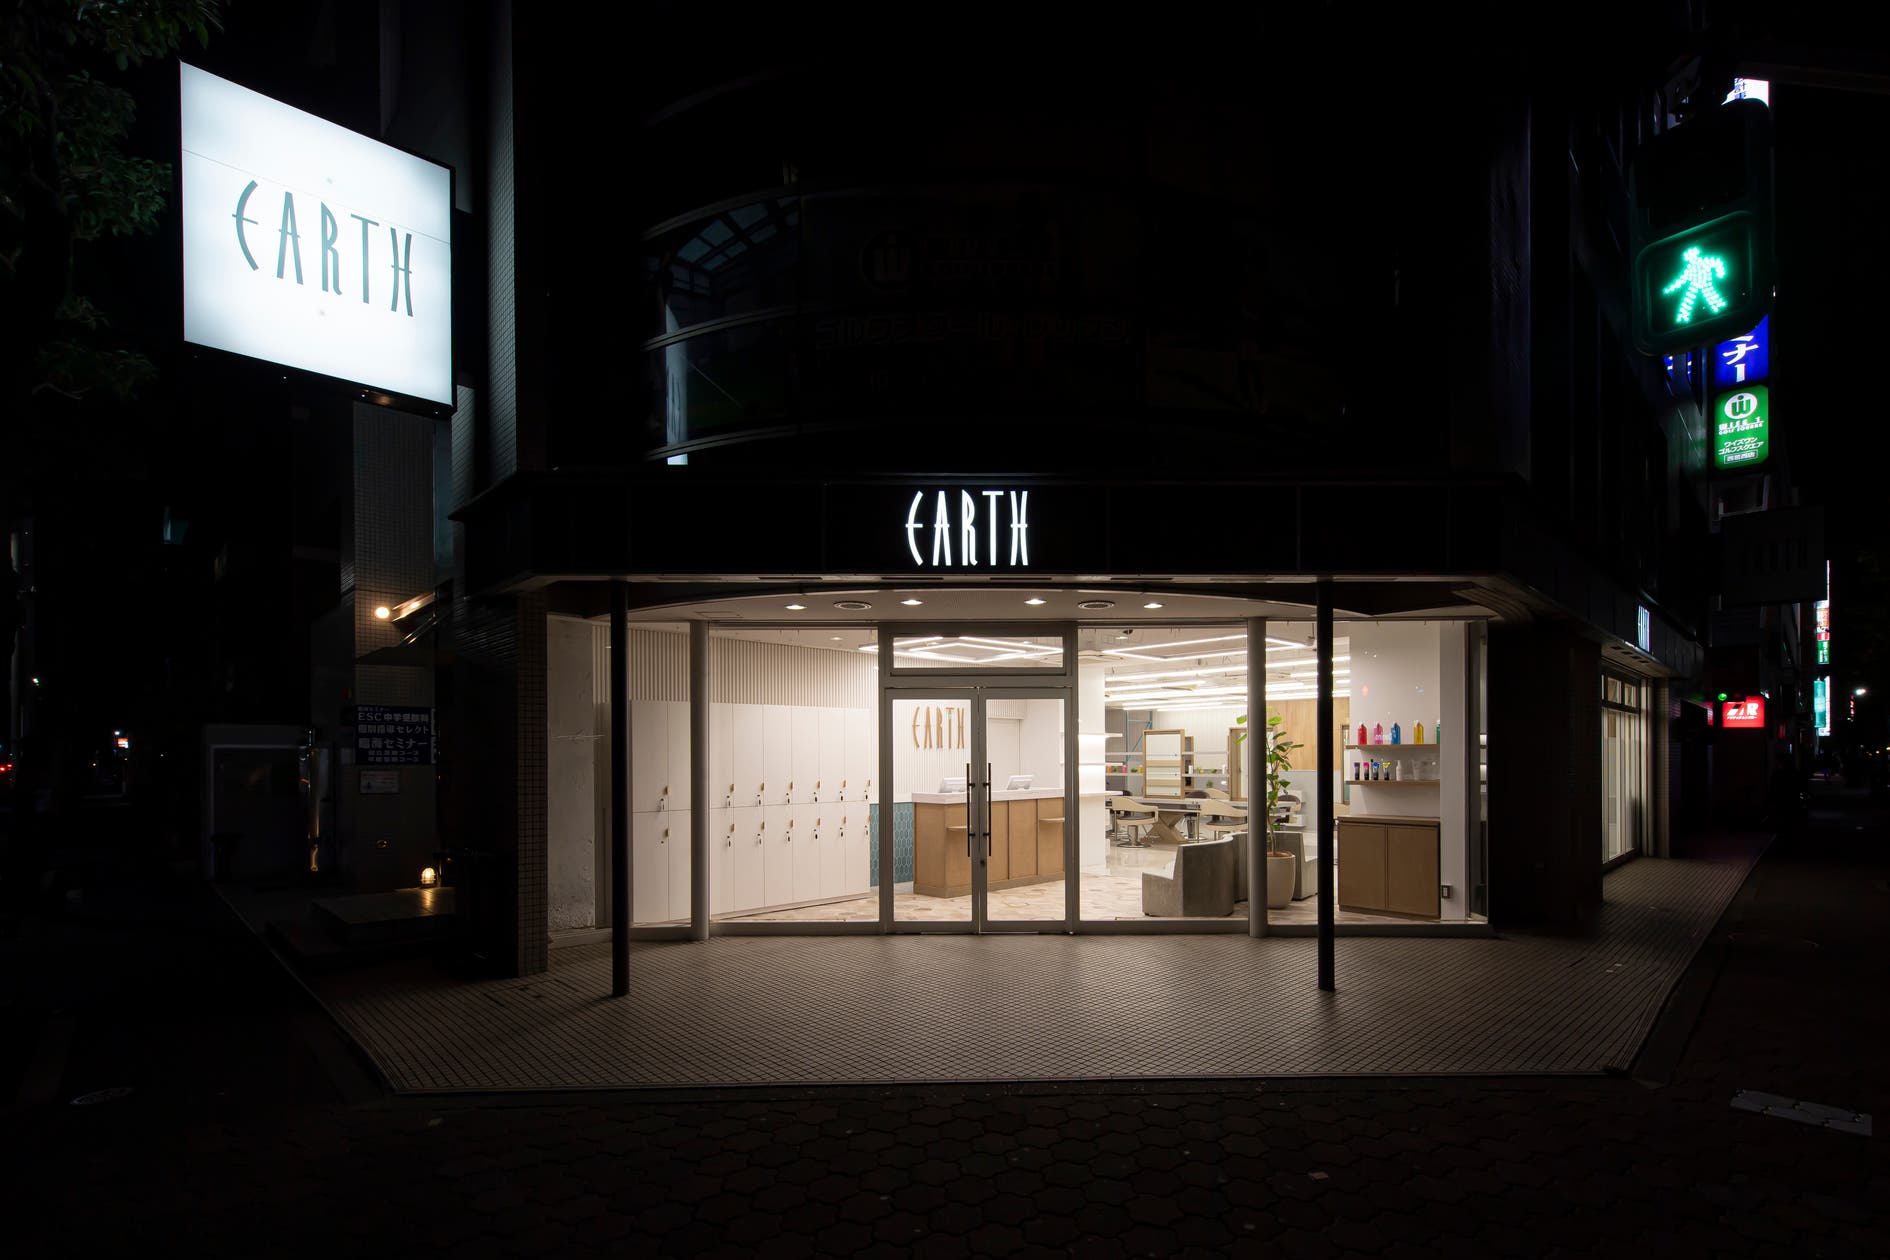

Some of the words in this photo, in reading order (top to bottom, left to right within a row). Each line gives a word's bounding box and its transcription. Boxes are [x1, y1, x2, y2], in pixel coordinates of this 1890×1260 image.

[231, 179, 414, 318] EARTH
[905, 489, 1029, 567] EARTH
[912, 706, 965, 750] EARTH
